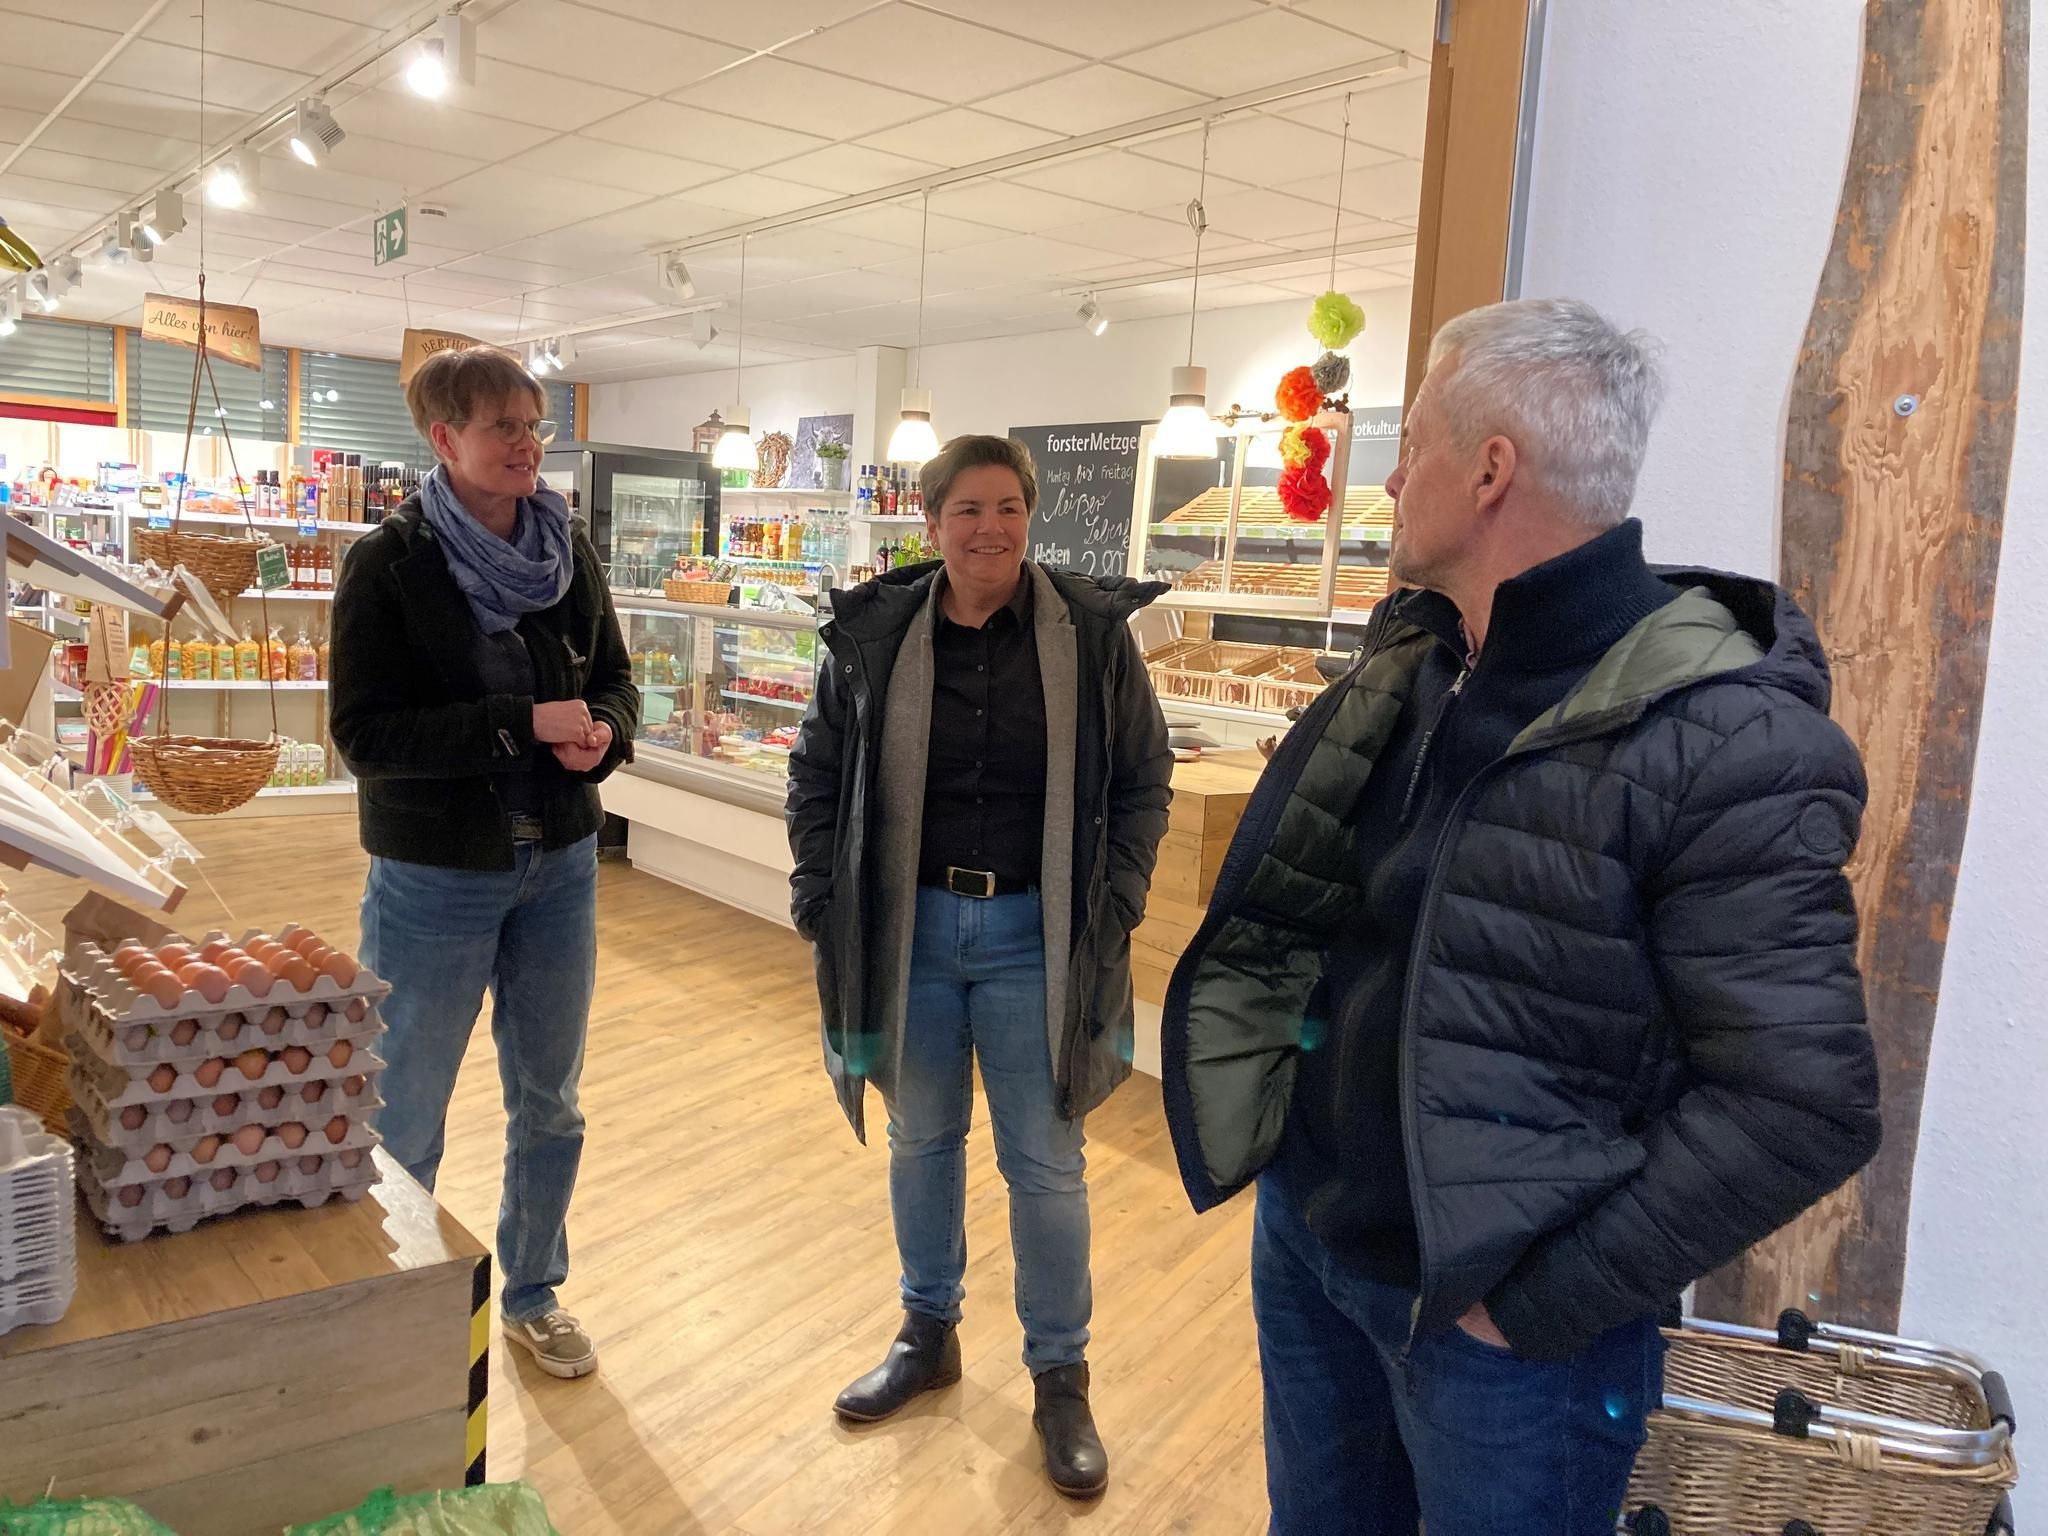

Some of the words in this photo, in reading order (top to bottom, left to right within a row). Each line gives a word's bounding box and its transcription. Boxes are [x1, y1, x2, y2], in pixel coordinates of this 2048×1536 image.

[149, 310, 188, 329] Alles
[222, 320, 254, 340] hier!
[1074, 463, 1095, 485] bis
[1101, 463, 1134, 485] Freitag
